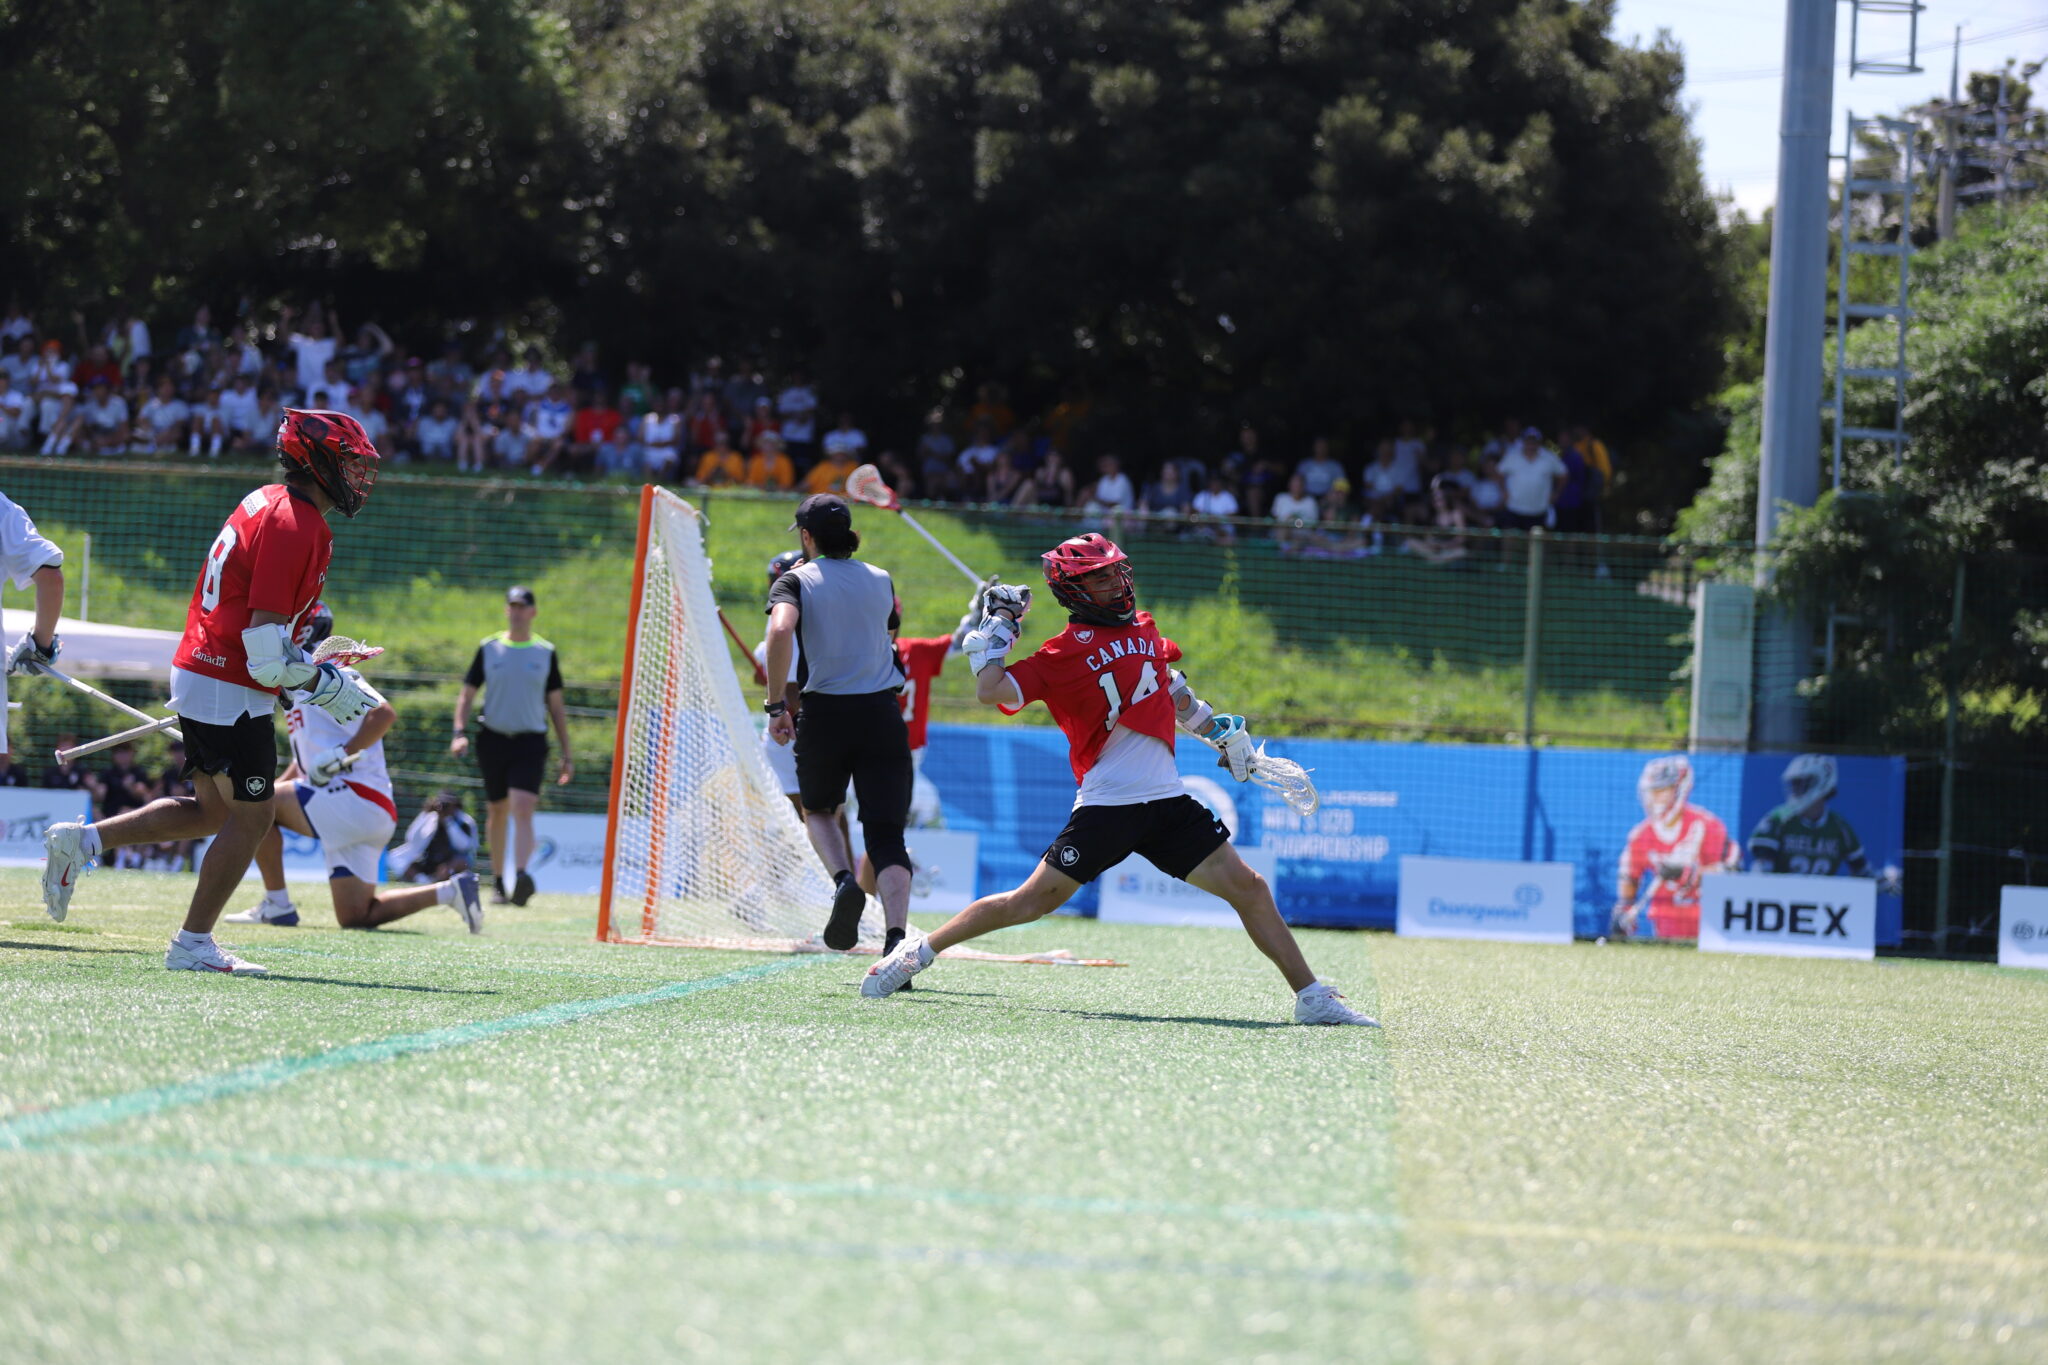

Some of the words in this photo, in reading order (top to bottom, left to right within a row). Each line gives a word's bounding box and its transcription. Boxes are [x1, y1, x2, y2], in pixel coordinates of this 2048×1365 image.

[191, 646, 227, 668] Canada
[1085, 637, 1156, 672] CANADA
[1098, 660, 1160, 732] 14
[286, 708, 305, 735] SA
[1723, 898, 1849, 937] HDEX
